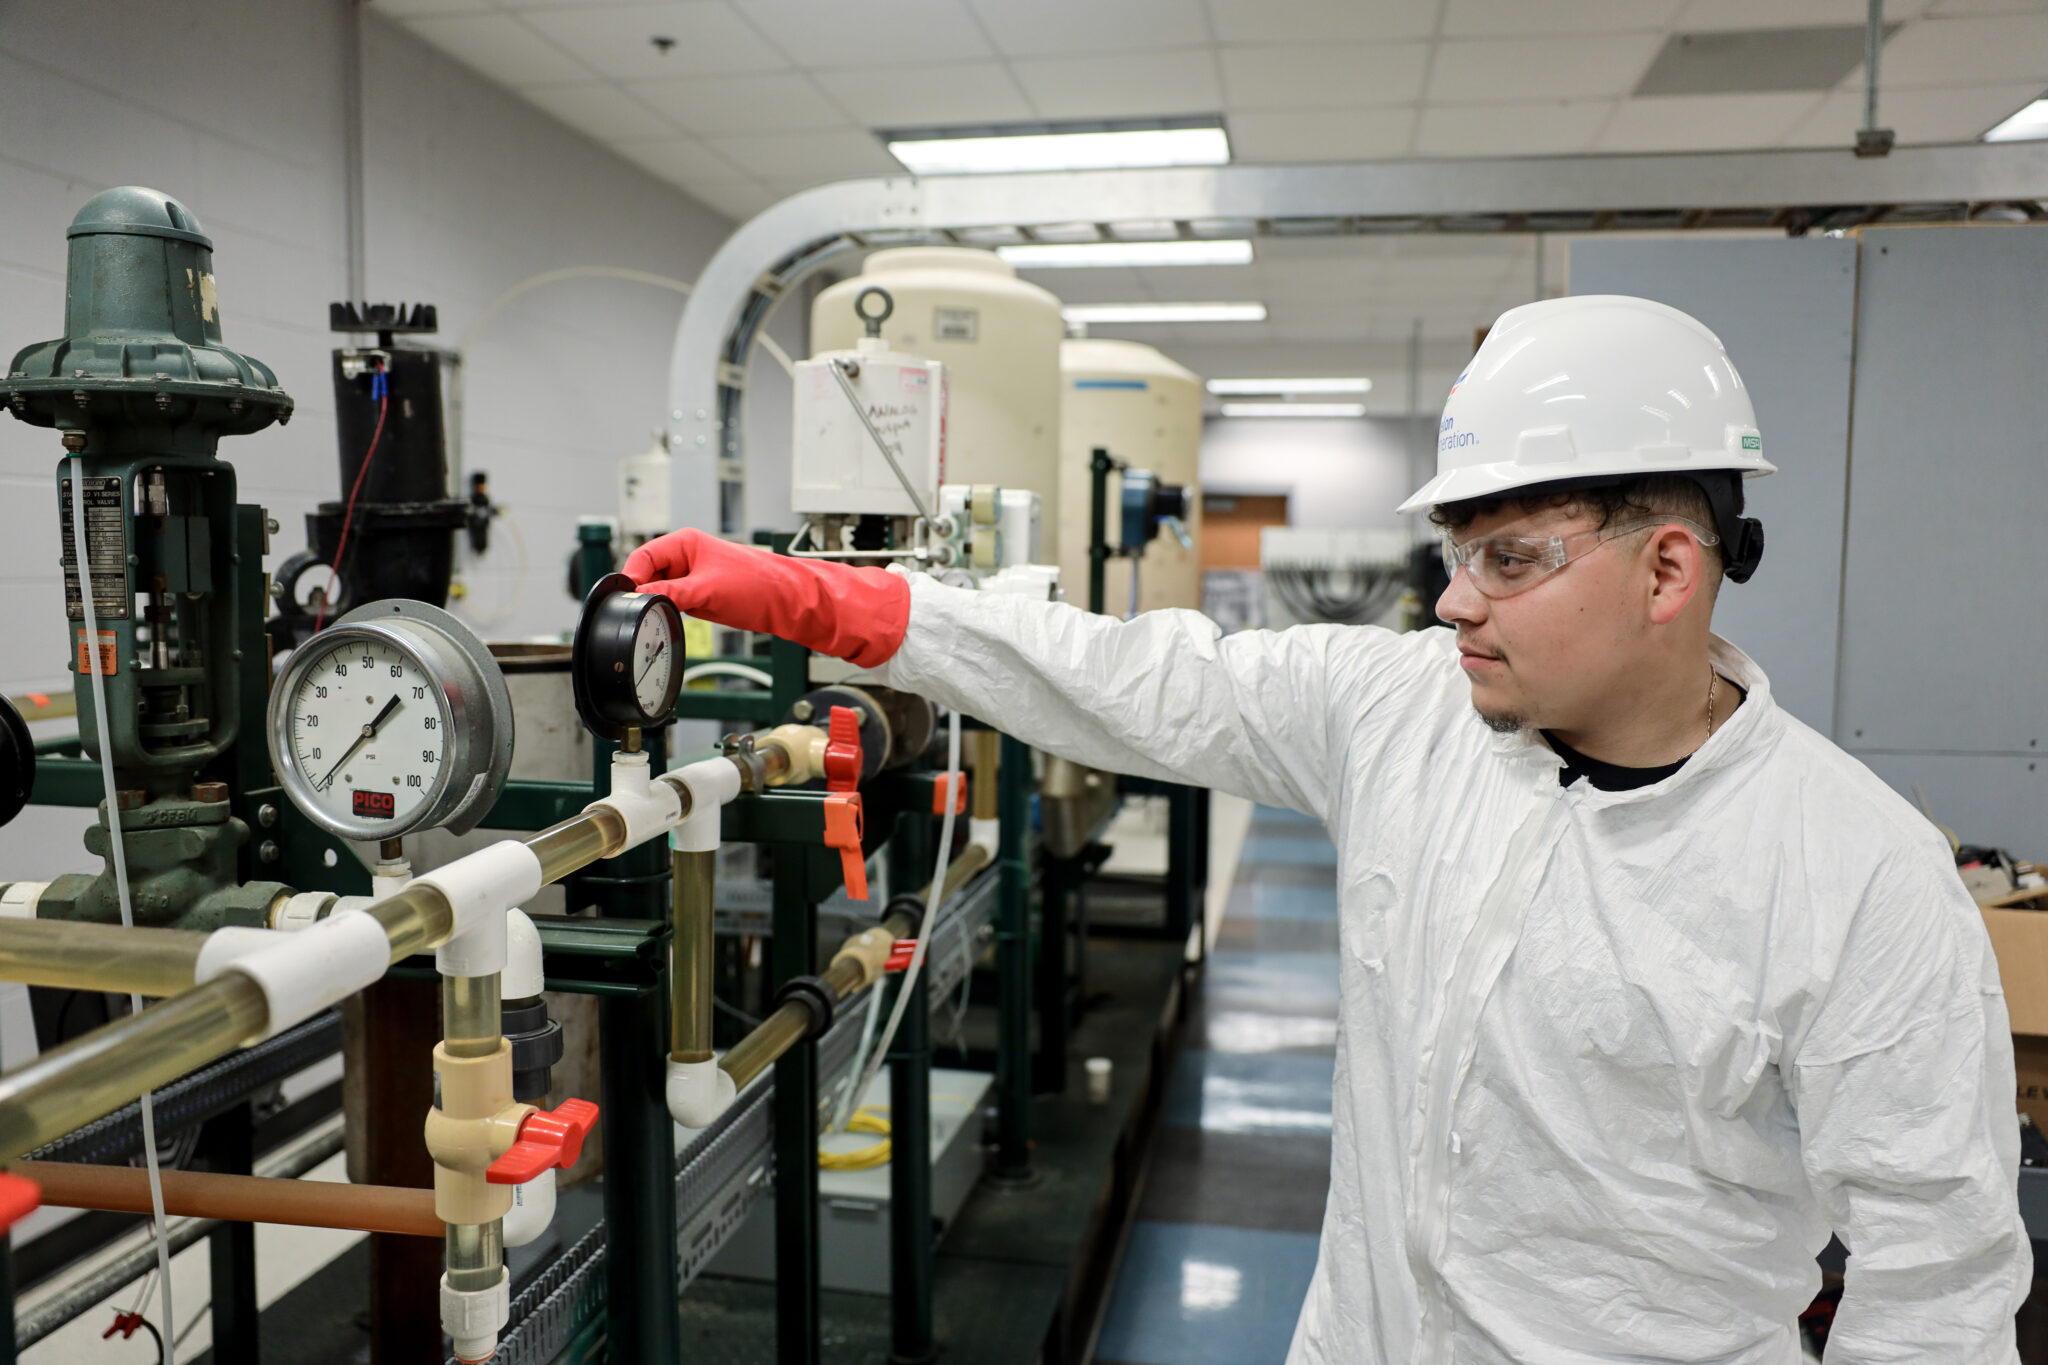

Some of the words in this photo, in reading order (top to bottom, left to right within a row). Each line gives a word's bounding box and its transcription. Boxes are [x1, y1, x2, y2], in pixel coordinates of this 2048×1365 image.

[362, 656, 374, 669] 50
[335, 664, 347, 676] 40
[390, 665, 402, 678] 60
[316, 686, 327, 698] 30
[412, 687, 424, 699] 70
[307, 715, 318, 727] 20
[424, 717, 436, 730] 80
[312, 747, 321, 760] 10
[422, 750, 434, 763] 90
[407, 774, 421, 787] 100
[353, 791, 394, 809] PICO
